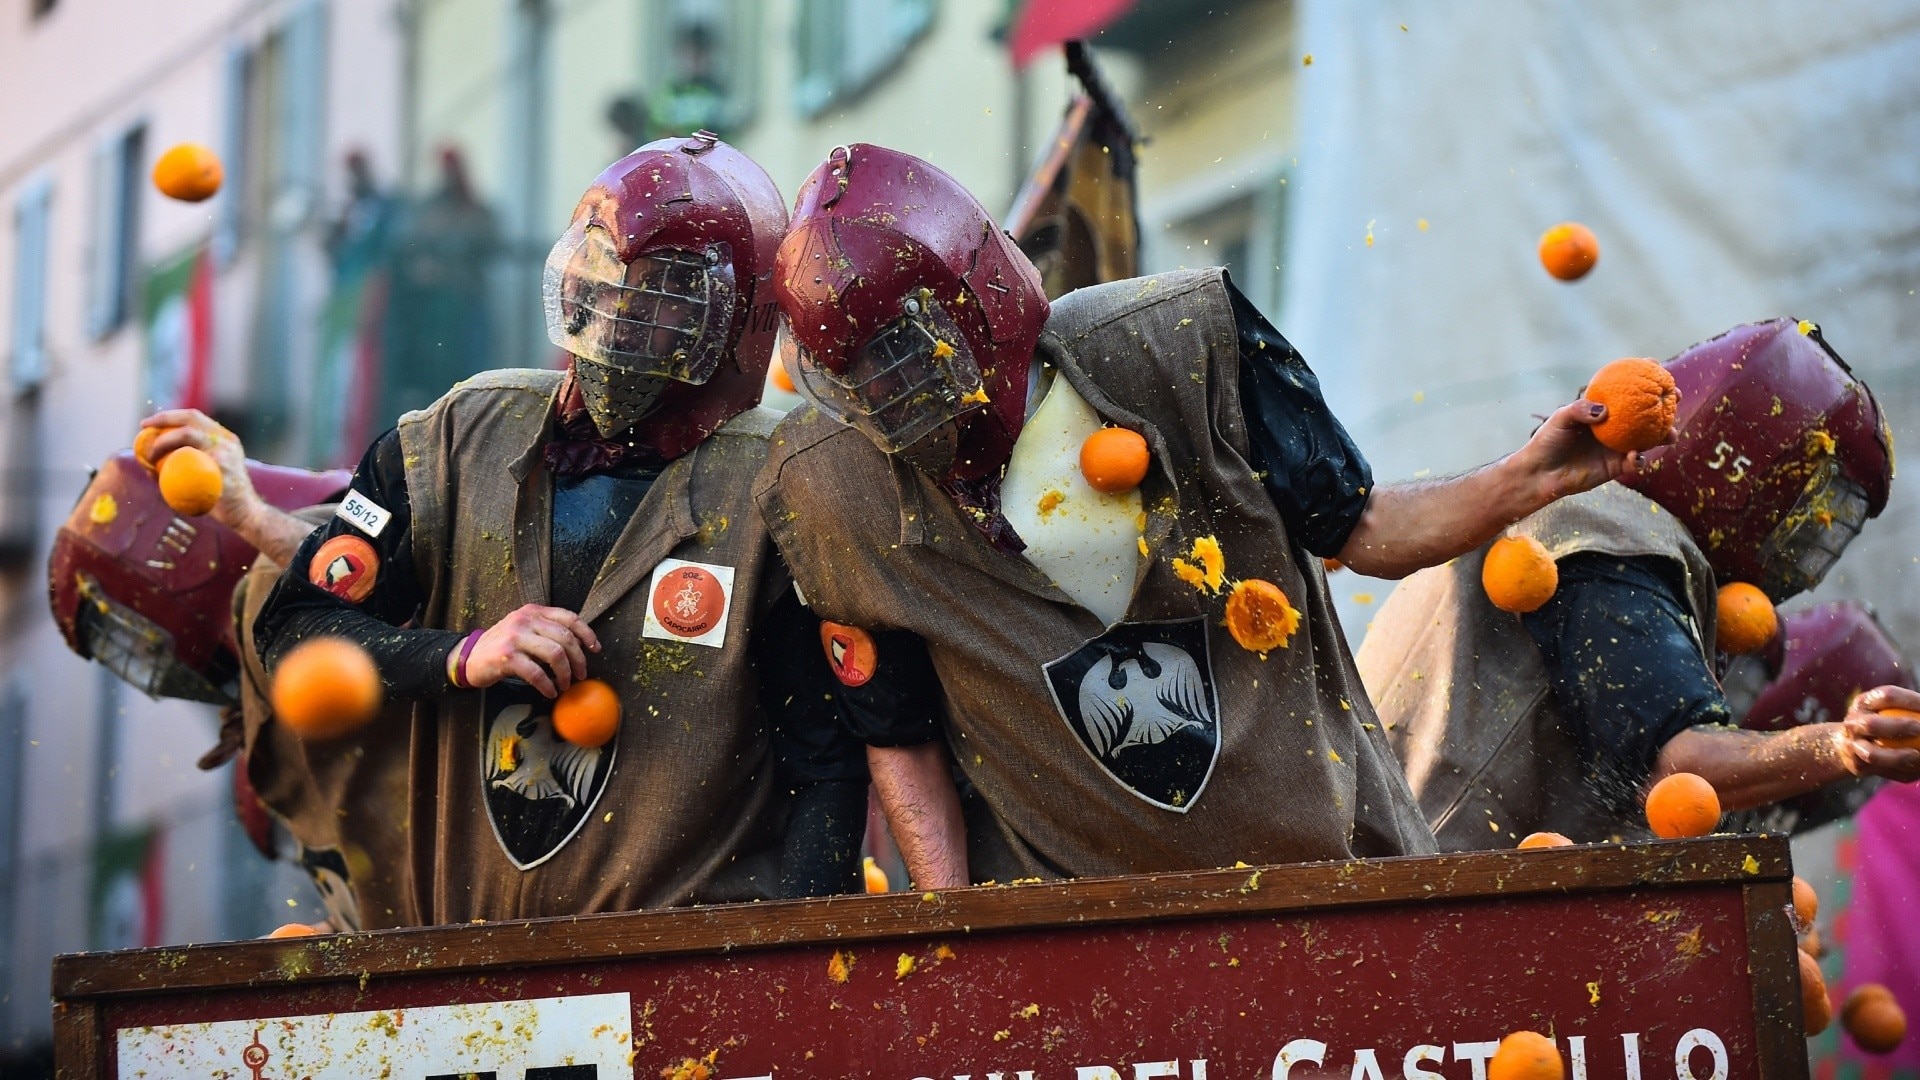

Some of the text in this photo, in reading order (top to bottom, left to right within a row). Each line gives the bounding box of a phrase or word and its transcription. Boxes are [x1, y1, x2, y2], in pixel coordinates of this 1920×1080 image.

[1708, 441, 1752, 483] 55
[345, 499, 379, 528] 55/12
[663, 616, 707, 633] CAPOCARRO
[1271, 1028, 1730, 1080] CASTLLO
